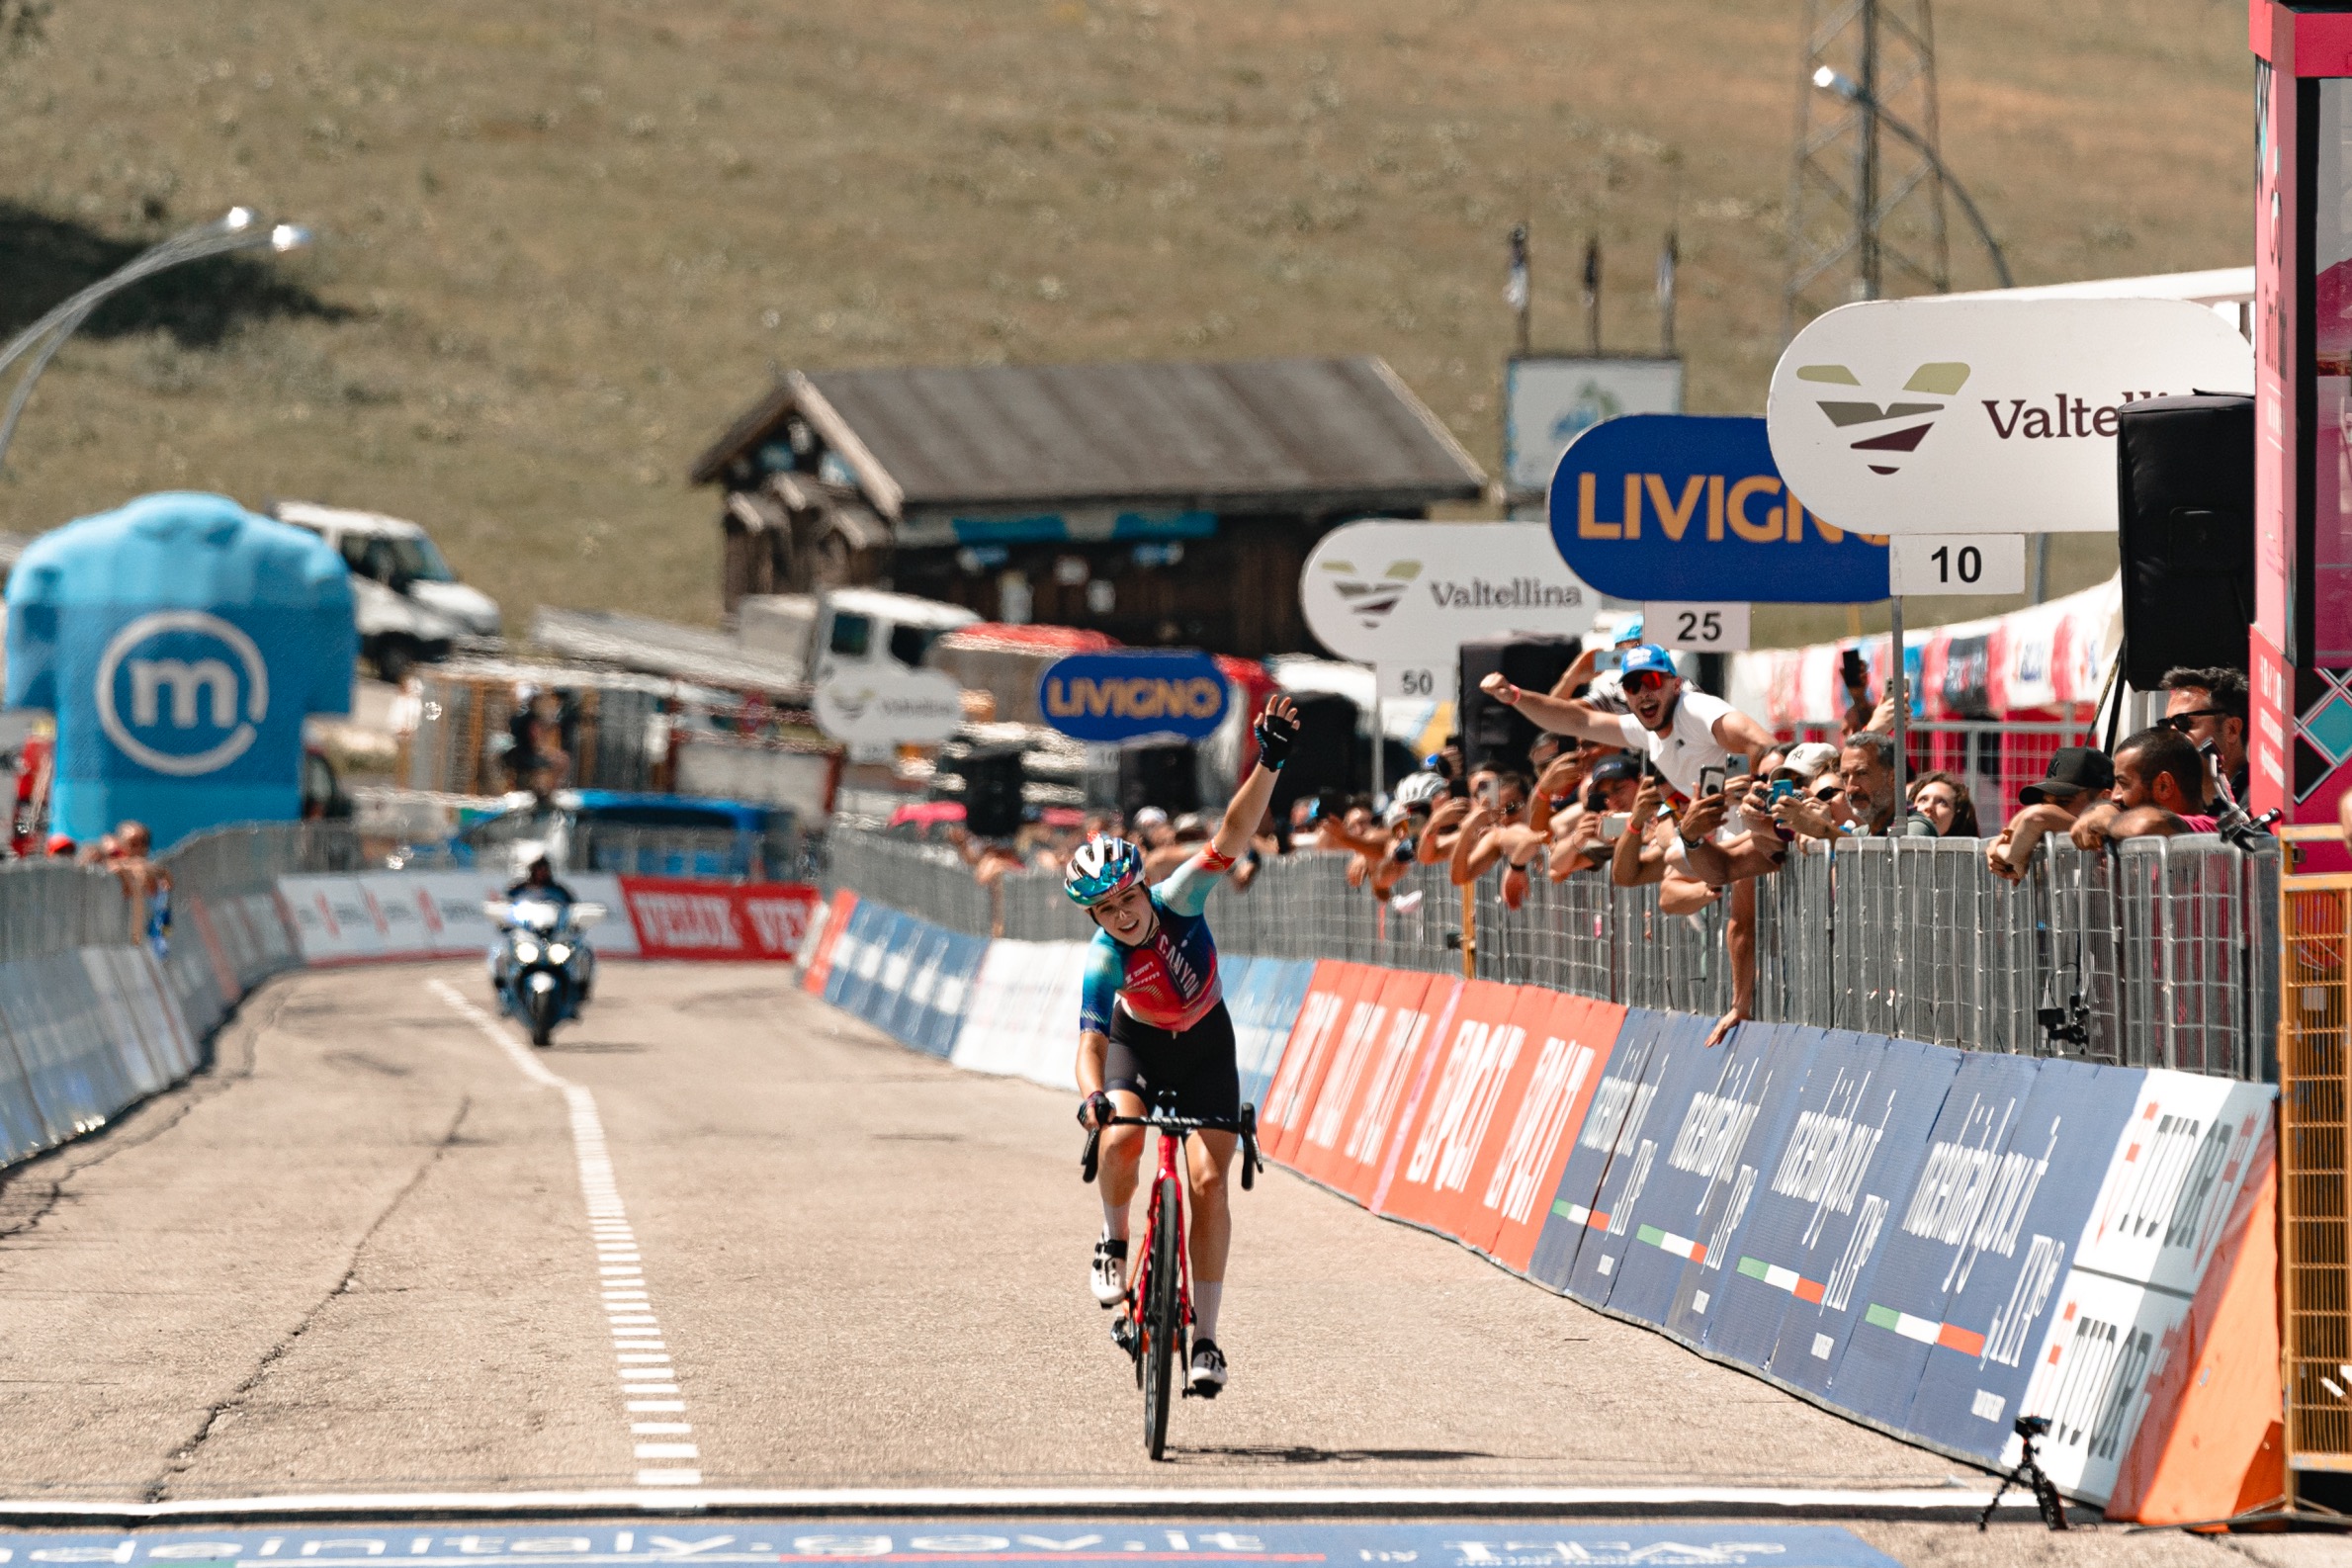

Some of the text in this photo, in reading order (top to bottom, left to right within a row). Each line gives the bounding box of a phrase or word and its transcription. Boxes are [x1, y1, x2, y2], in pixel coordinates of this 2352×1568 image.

[1981, 392, 2168, 439] Valte
[1578, 473, 1890, 546] LIVIGN
[1930, 546, 1983, 584] 10
[1430, 576, 1583, 608] Valtellina
[1677, 610, 1723, 642] 25
[1046, 676, 1222, 719] LIVIGNO
[1401, 668, 1434, 696] 50
[1159, 934, 1199, 1000] CANYON
[2119, 1113, 2233, 1250] TUDOR
[2047, 1315, 2153, 1462] TUDOR
[0, 1529, 1267, 1563] deinitaly.gov.it
